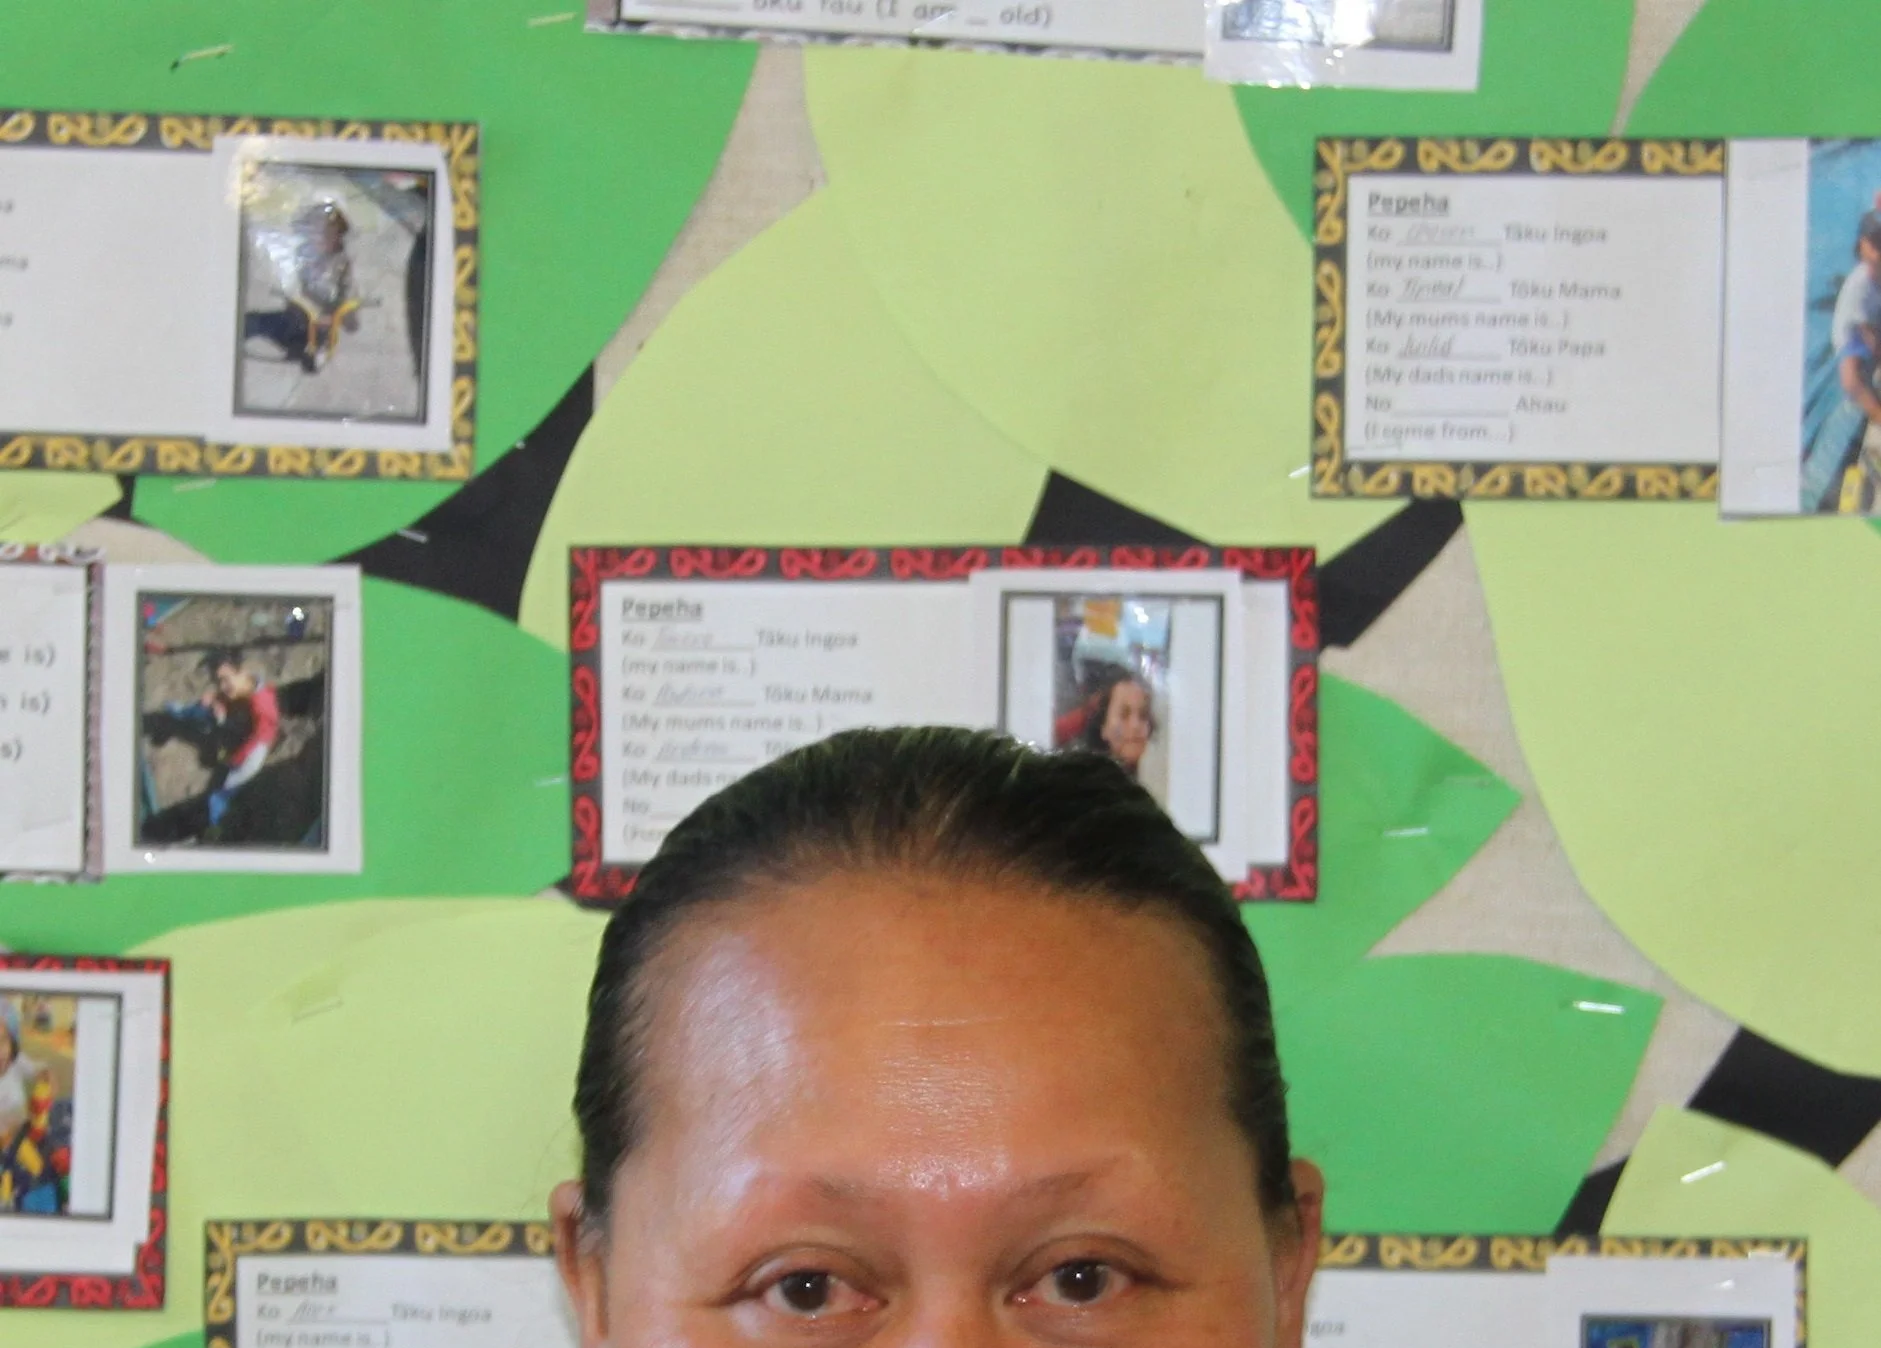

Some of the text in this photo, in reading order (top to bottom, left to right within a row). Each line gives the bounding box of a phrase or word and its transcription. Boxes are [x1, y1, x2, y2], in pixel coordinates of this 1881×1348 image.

[998, 4, 1054, 29] old)
[1367, 191, 1450, 218] Pepeha
[1366, 223, 1392, 243] Ko
[1365, 249, 1403, 273] (my
[1407, 254, 1464, 270] name
[1366, 279, 1392, 299] Ko
[1558, 279, 1623, 300] Mama
[1365, 307, 1403, 331] (My
[1408, 310, 1470, 328] mums
[1474, 310, 1530, 328] name
[1365, 336, 1391, 355] Ko
[1557, 337, 1607, 361] Papa
[1364, 364, 1403, 387] (My
[1408, 365, 1455, 387] dads
[1458, 370, 1514, 387] name
[1364, 394, 1568, 415] No Ahau
[621, 597, 704, 624] Pepeha
[621, 627, 647, 647] Ko
[621, 655, 658, 679] (my
[662, 659, 719, 676] name
[621, 685, 647, 704] Ko
[811, 684, 874, 705] Mama
[621, 711, 659, 735] (My
[665, 714, 725, 732] mums
[729, 715, 784, 732] name
[621, 740, 647, 759] Ko
[621, 768, 660, 791] (My
[665, 768, 712, 787] dads
[256, 1268, 338, 1296] Pepeha
[256, 1301, 281, 1320] Ko
[297, 1332, 352, 1348] name
